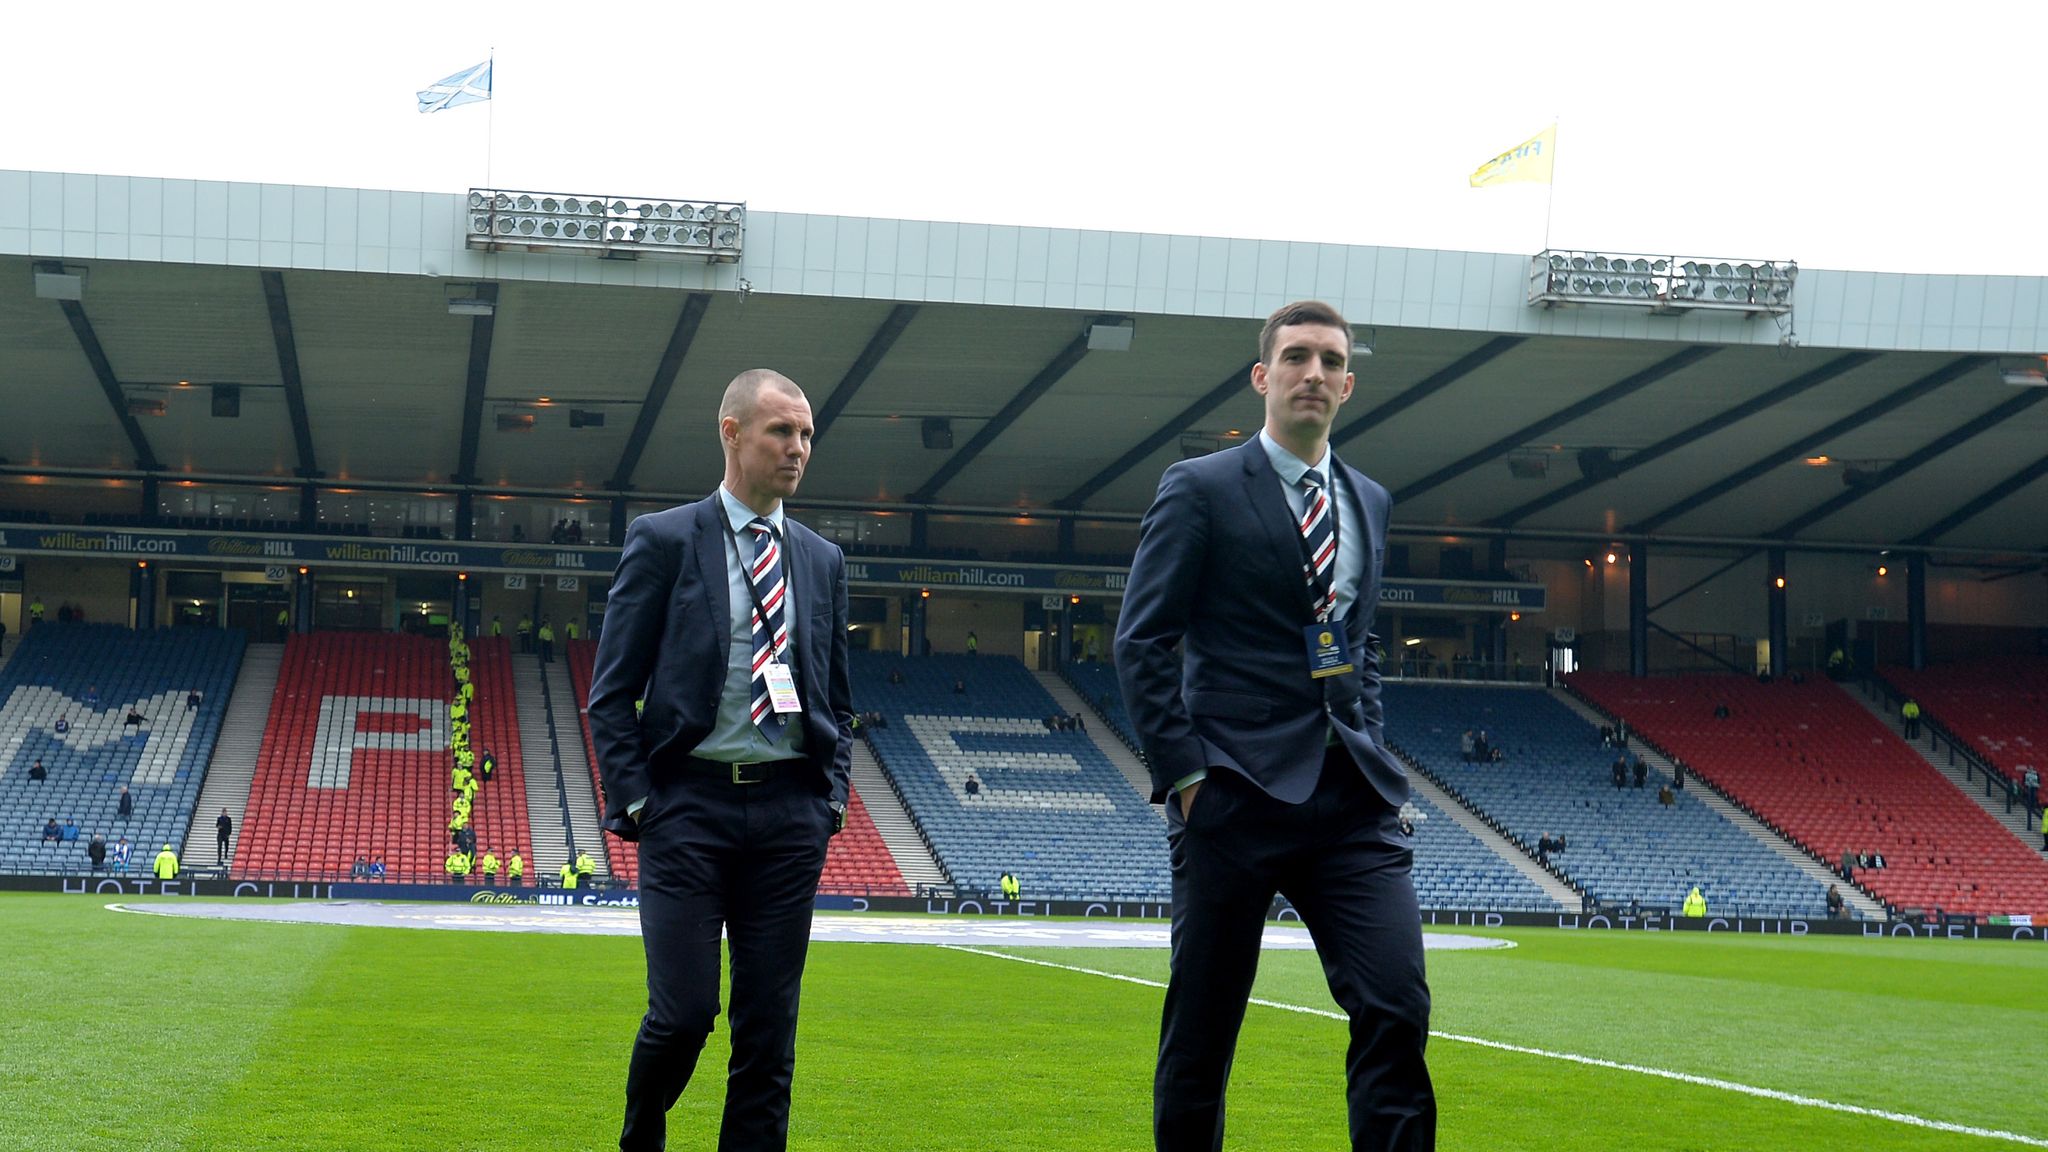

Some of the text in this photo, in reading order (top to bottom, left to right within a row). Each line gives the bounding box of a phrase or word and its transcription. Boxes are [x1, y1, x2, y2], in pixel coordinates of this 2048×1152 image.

[40, 532, 177, 552] williamhill.com
[264, 541, 295, 556] HILL
[326, 543, 460, 565] williamhill.com
[555, 552, 585, 568] HILL
[268, 567, 285, 578] 20
[898, 565, 1025, 586] williamhill.com
[508, 576, 522, 587] 21
[560, 579, 577, 589] 22
[1105, 573, 1129, 589] HIL
[1492, 588, 1521, 605] HILL
